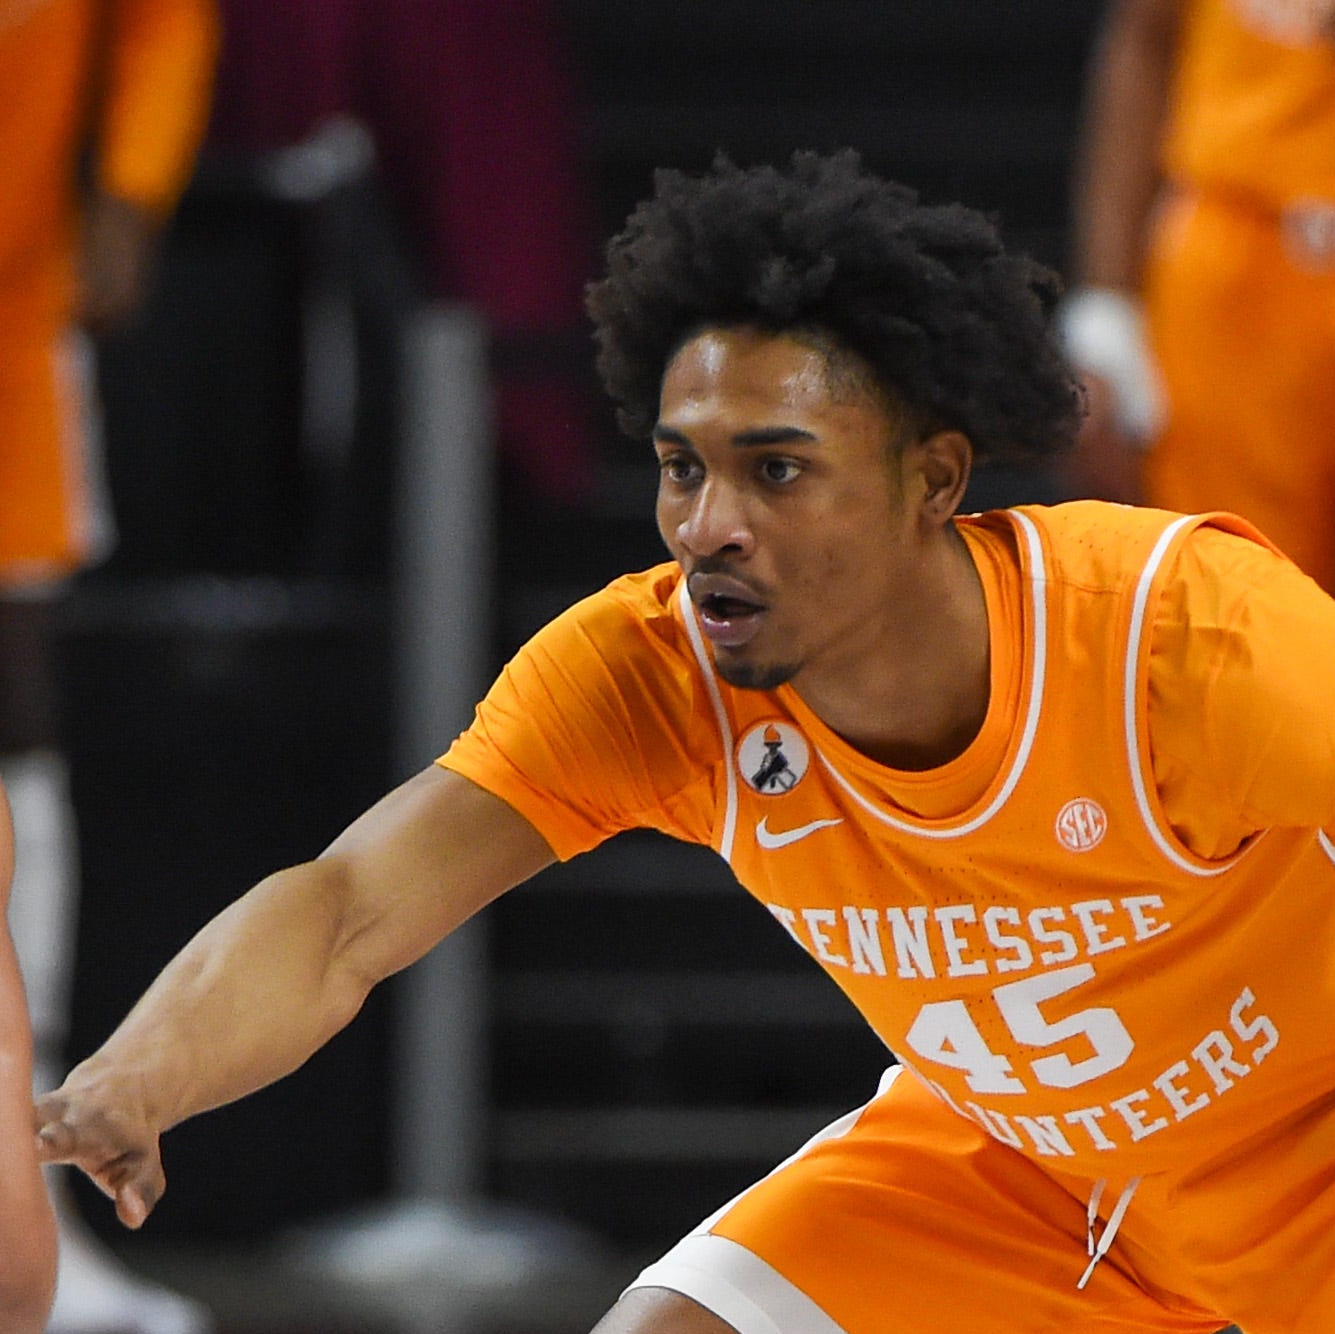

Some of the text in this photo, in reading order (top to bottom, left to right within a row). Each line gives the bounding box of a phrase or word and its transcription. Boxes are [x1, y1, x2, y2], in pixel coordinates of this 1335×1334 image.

[1058, 803, 1104, 849] SEC
[905, 962, 1135, 1095] 45
[928, 986, 1280, 1157] UNTEERS
